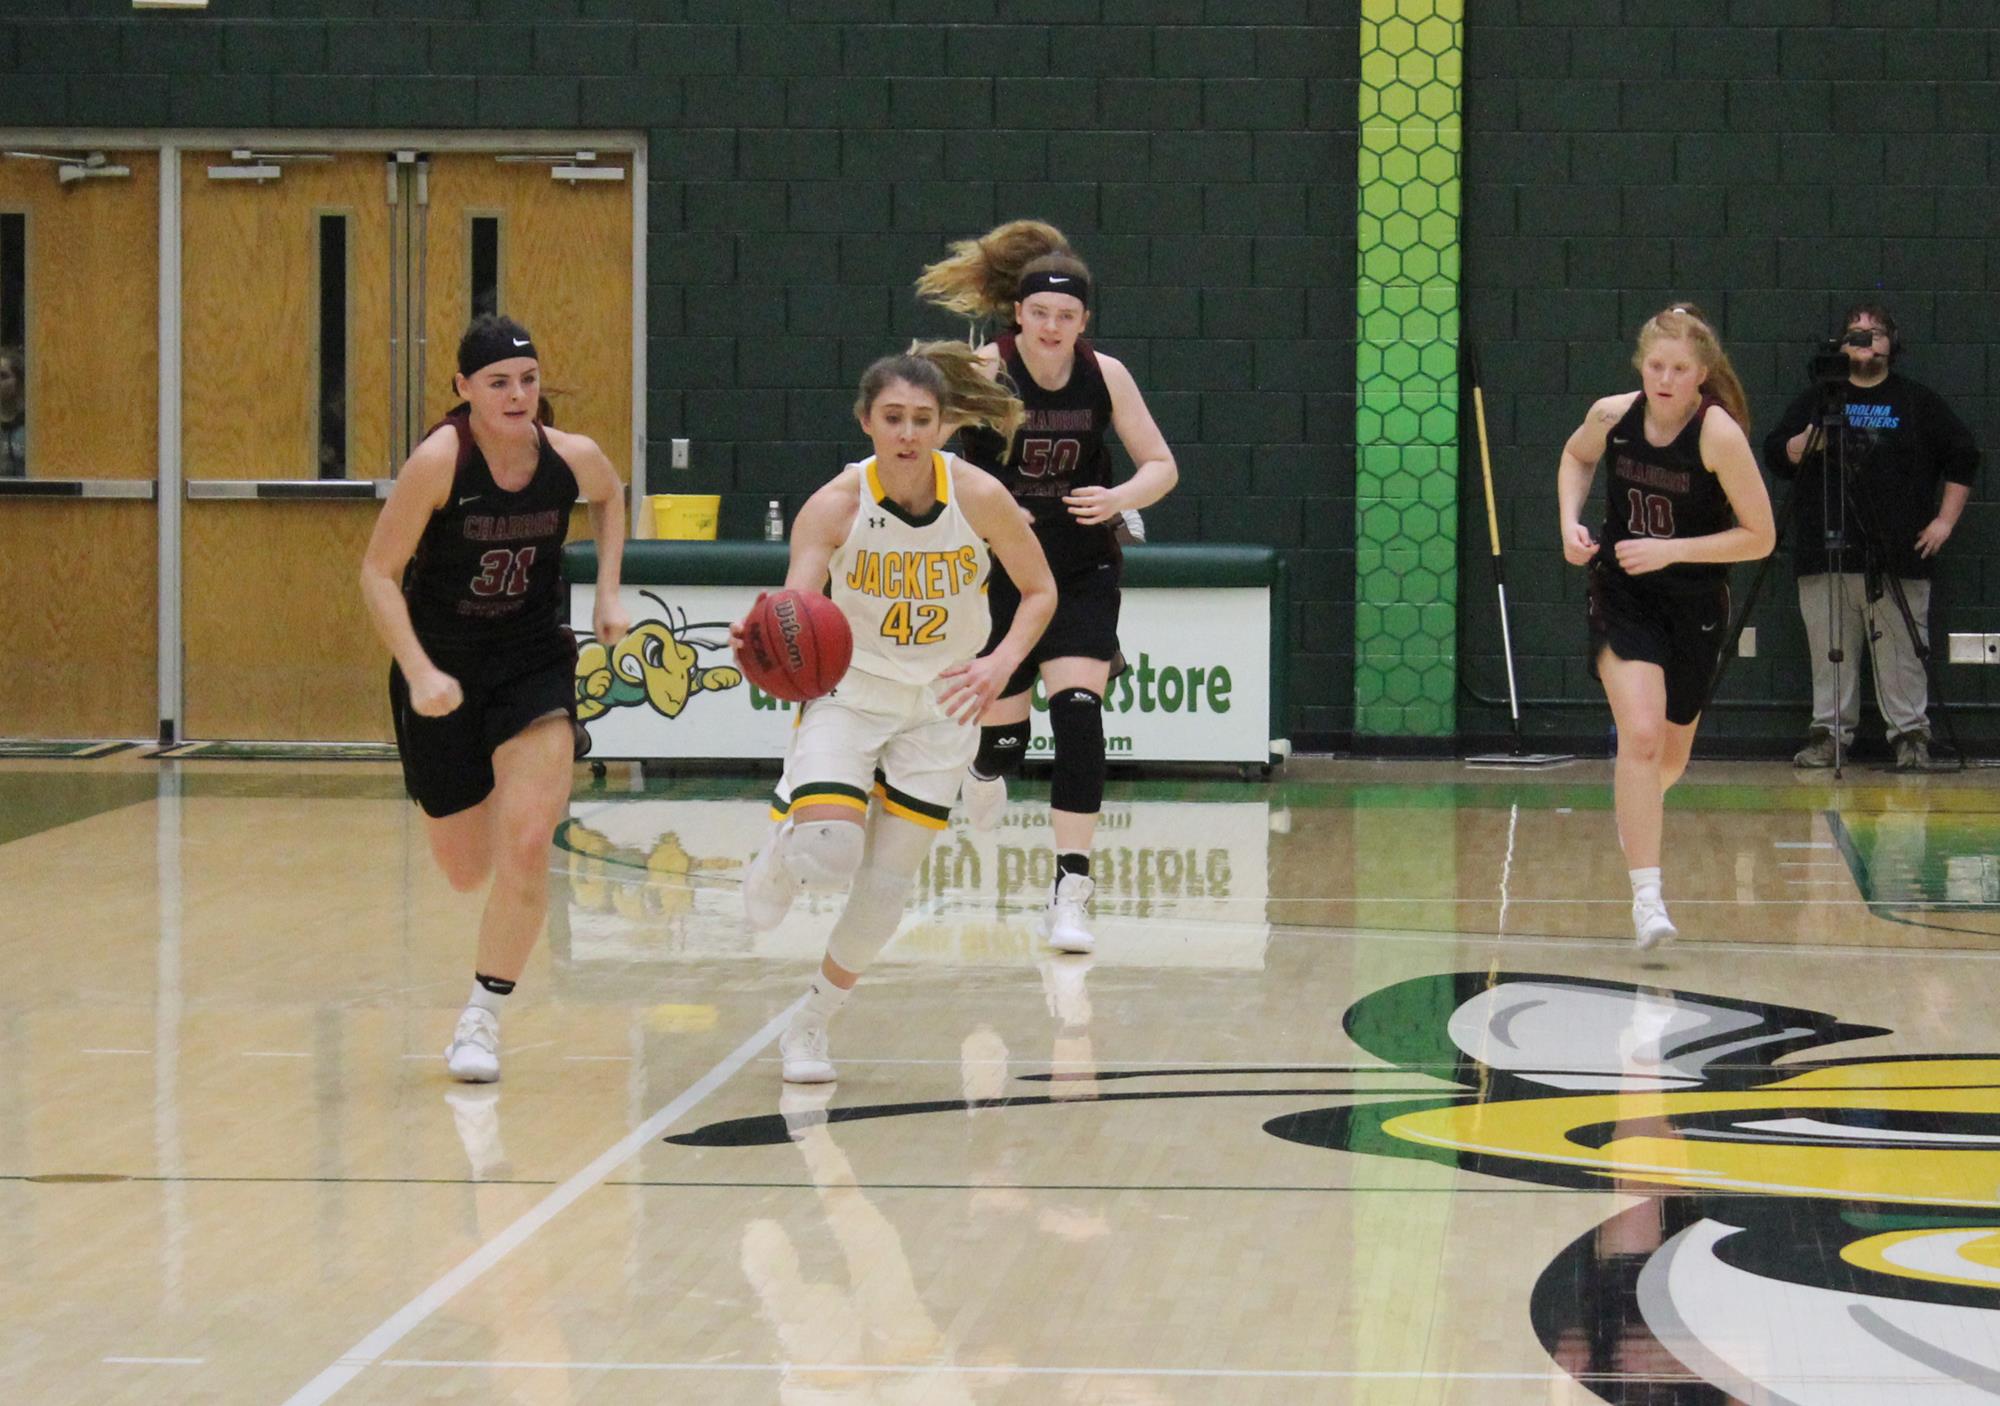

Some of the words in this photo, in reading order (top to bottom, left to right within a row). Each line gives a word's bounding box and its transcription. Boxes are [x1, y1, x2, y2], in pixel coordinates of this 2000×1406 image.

[1842, 404, 1892, 416] AROLINA
[1849, 416, 1900, 429] ANTHERS
[1017, 438, 1081, 478] 50
[1627, 487, 1675, 539] 10
[470, 546, 536, 596] 31
[847, 545, 978, 600] JACKETS
[774, 599, 804, 674] Wilson
[880, 602, 949, 646] 42
